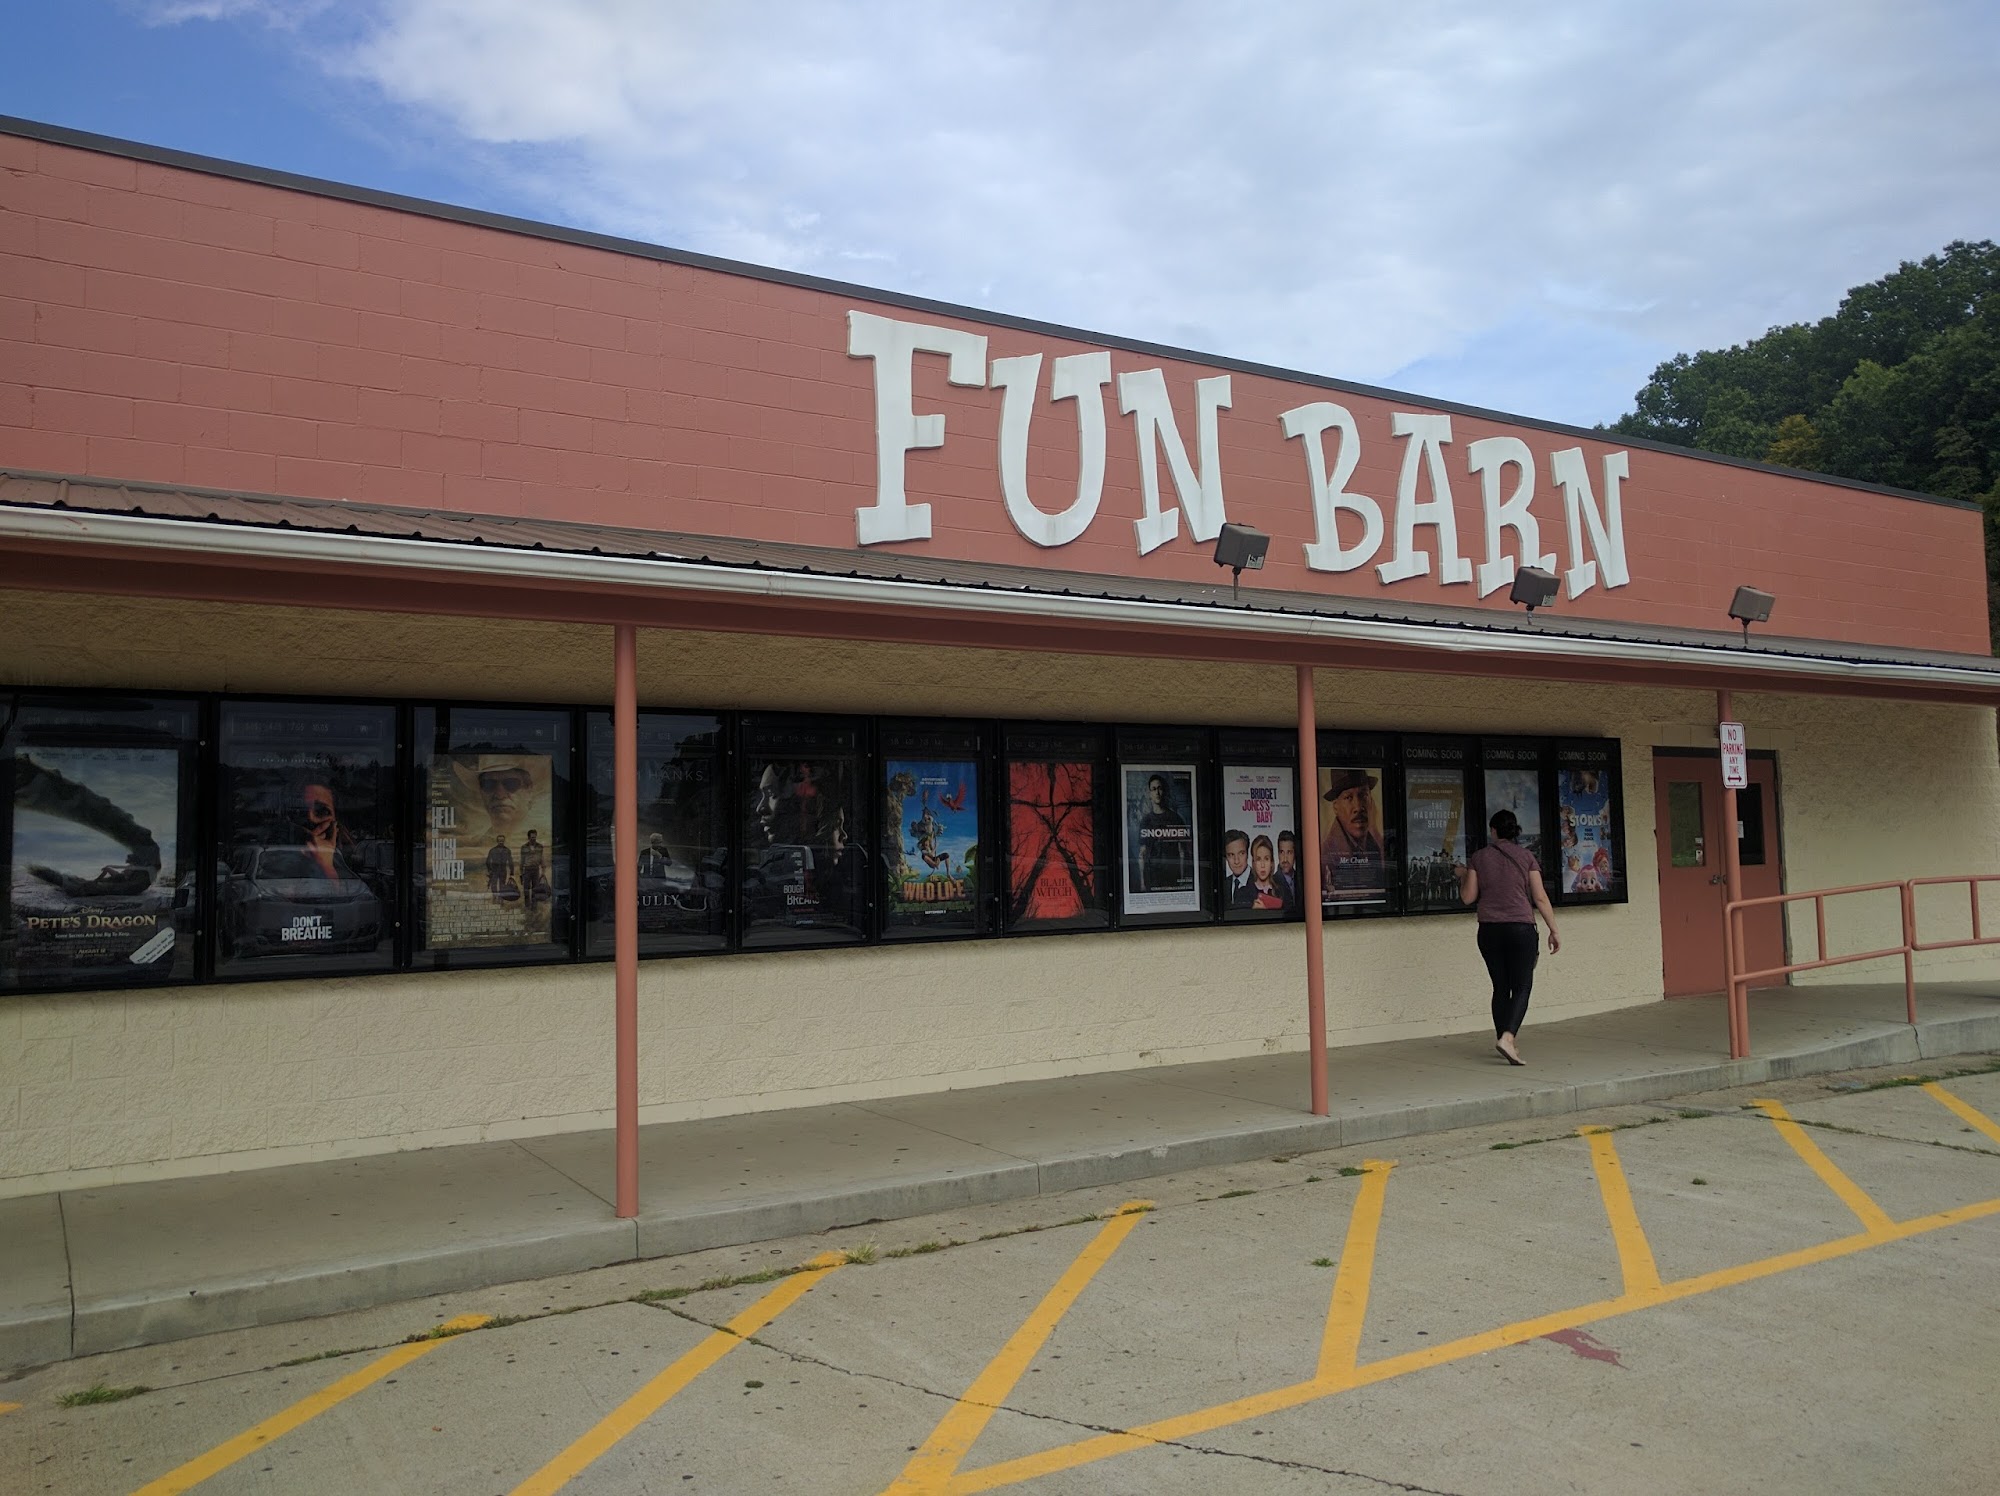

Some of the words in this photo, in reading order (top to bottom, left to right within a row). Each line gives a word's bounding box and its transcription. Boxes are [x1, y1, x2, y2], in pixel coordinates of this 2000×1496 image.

[846, 310, 1232, 556] FUN
[1278, 402, 1630, 600] BARN
[1727, 729, 1737, 741] NO
[1406, 749, 1438, 759] COMING
[1441, 750, 1463, 760] SOON
[1486, 750, 1515, 760] COMING
[1517, 750, 1538, 760] SOON
[1723, 743, 1744, 755] PARKING
[1558, 751, 1585, 761] COMING
[1587, 751, 1608, 761] SOON
[649, 770, 704, 781] HANKS
[1729, 766, 1739, 774] TIME
[1250, 787, 1278, 800] BRIDGET
[1242, 799, 1270, 811] JONES'S
[1432, 802, 1443, 811] THE
[431, 806, 457, 829] HELL
[1256, 811, 1273, 823] BABY
[1569, 814, 1602, 827] STORKS
[1141, 828, 1191, 838] SNOWDEN
[431, 838, 457, 860] HIGH
[1340, 856, 1350, 864] Mr.
[431, 859, 465, 880] WATER
[1041, 878, 1067, 887] BLAIR
[783, 884, 804, 894] BOUGH
[903, 881, 935, 901] WILD
[1036, 887, 1072, 897] WITCH
[27, 916, 81, 930] PETE'S
[87, 914, 157, 930] DRAGON
[292, 915, 322, 928] DON'T
[281, 926, 333, 941] BREATHE
